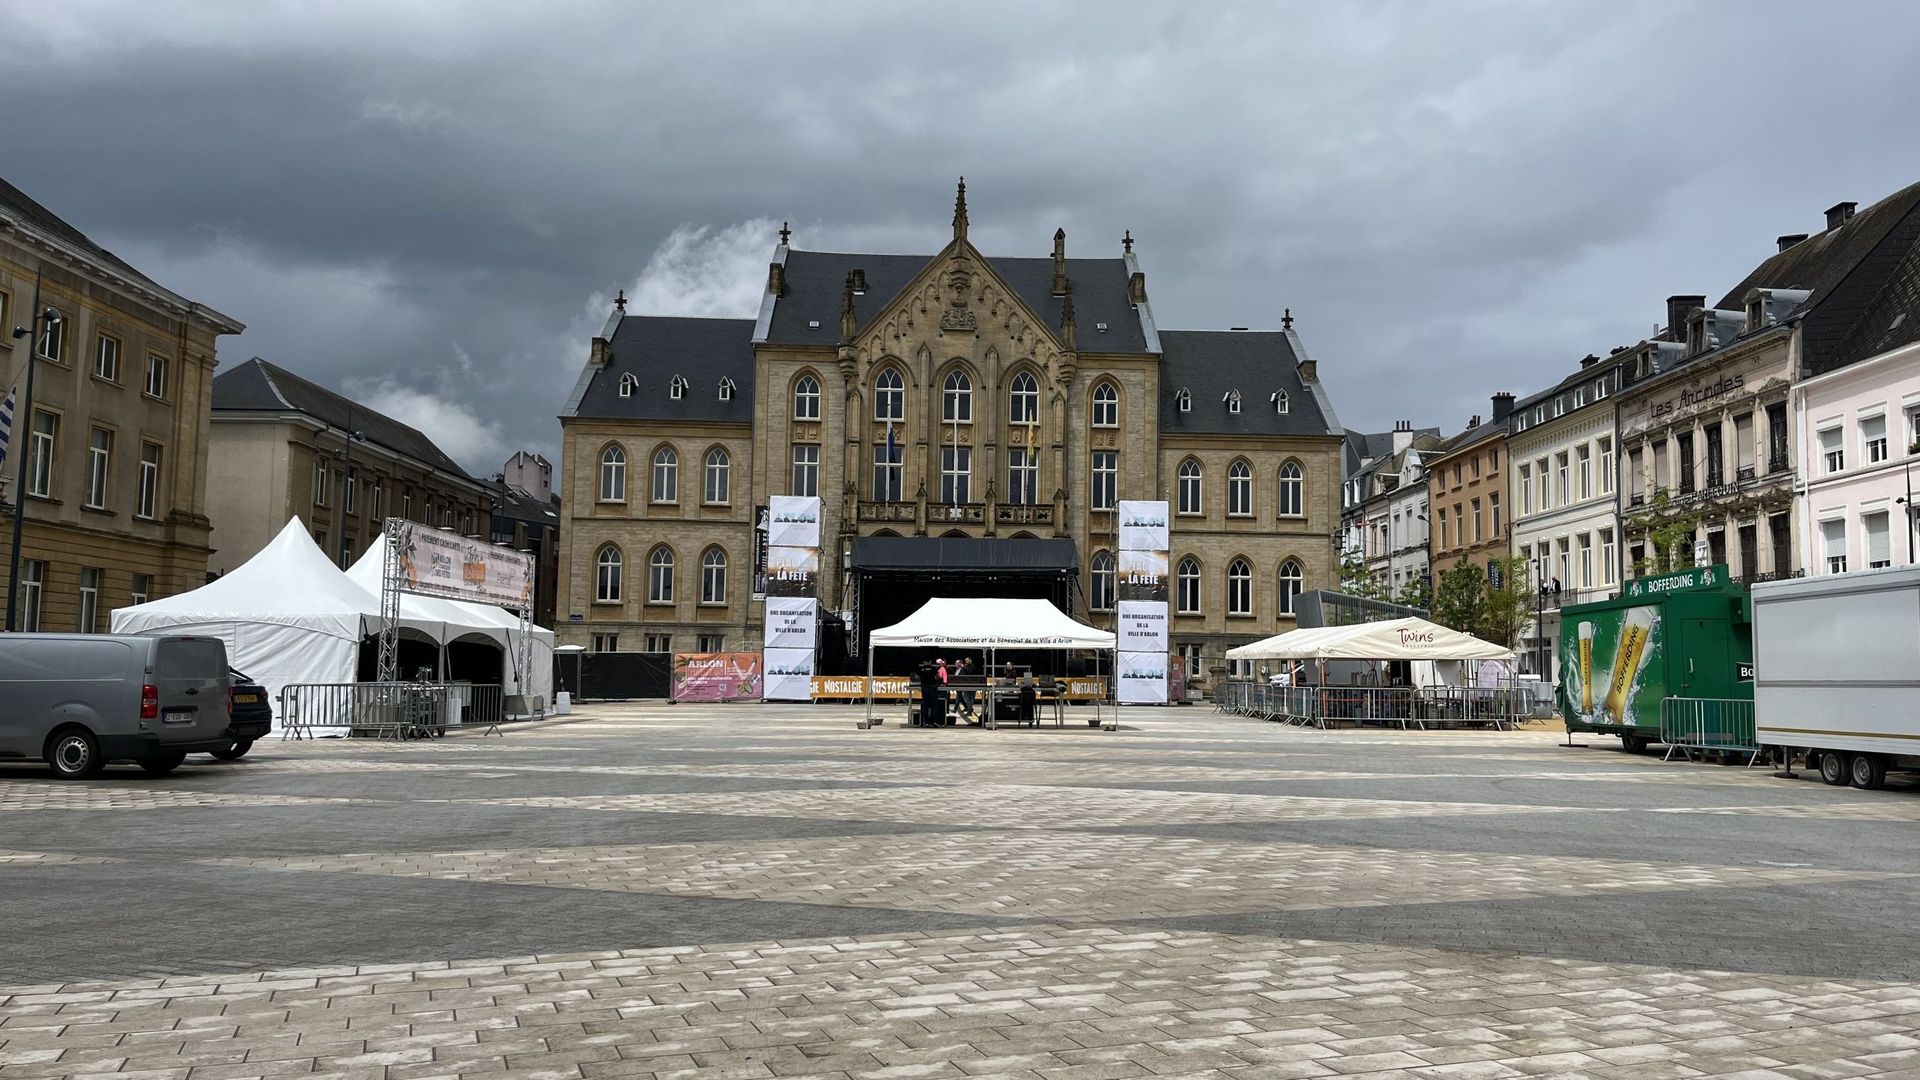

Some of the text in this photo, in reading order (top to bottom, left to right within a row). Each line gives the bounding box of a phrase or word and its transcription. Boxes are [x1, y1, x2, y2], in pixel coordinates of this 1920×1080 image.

[1649, 374, 1744, 419] Les Arcades
[777, 571, 787, 580] LA
[1128, 575, 1138, 584] LA
[1648, 574, 1693, 593] BOFFERDING
[1397, 628, 1434, 644] Twins
[688, 660, 723, 668] ARLON
[1616, 623, 1640, 695] BOFFERDING
[824, 680, 863, 693] NOSTALGIE
[1071, 681, 1102, 694] NOSTALGE
